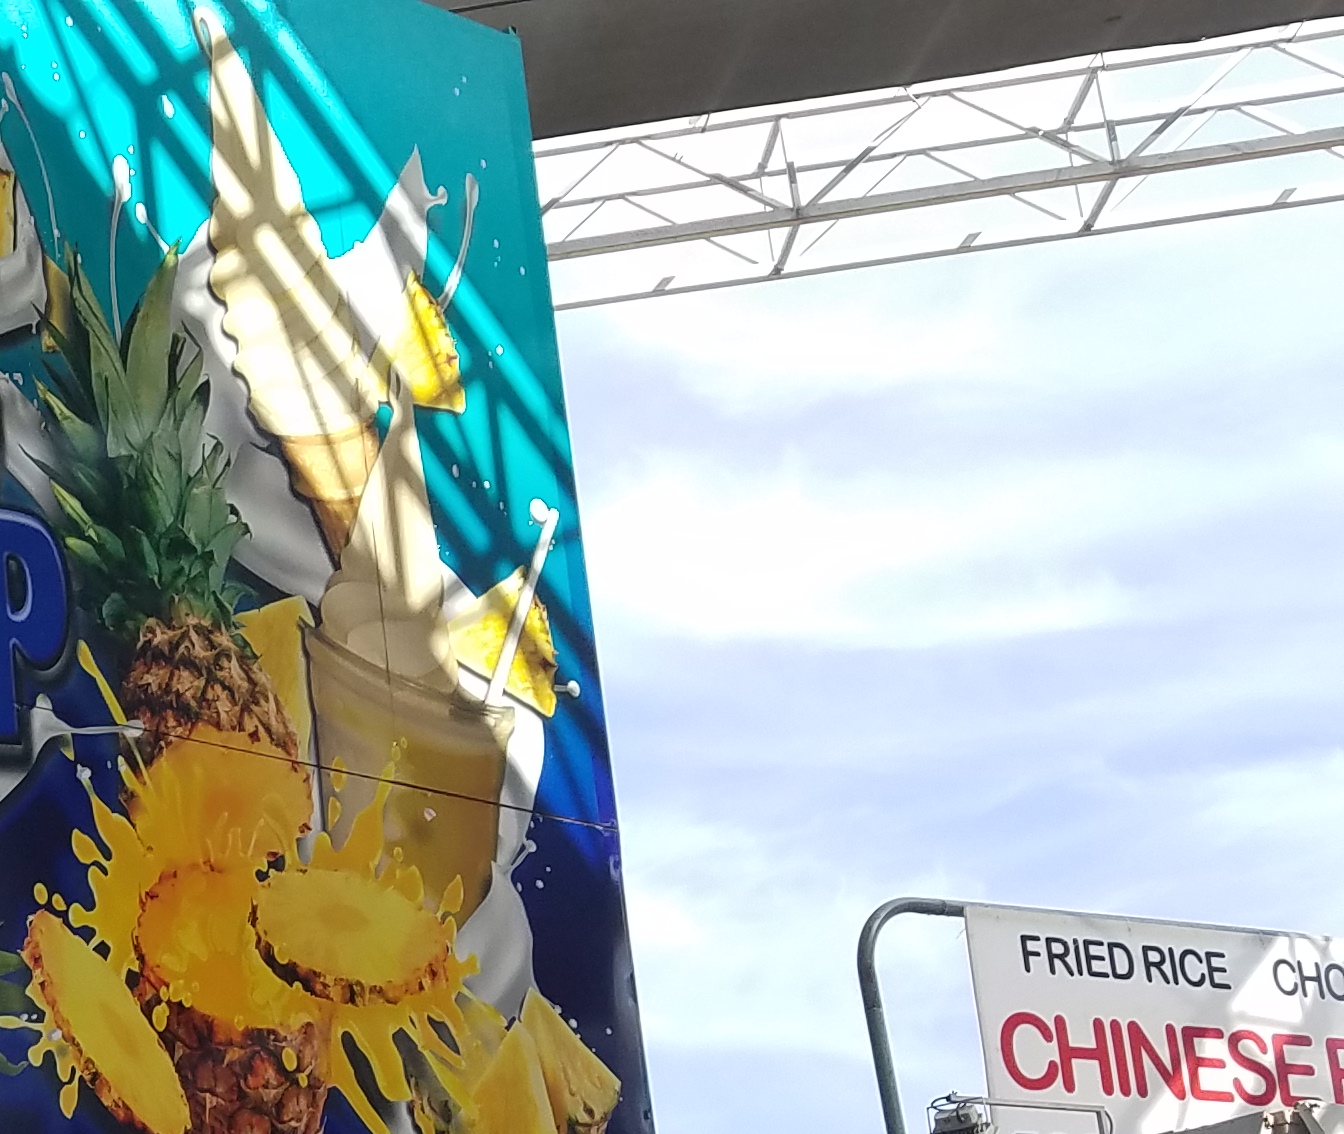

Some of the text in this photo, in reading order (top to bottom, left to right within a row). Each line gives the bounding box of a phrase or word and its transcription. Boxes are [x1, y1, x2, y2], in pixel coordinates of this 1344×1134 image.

[1019, 933, 1135, 980] FRIED
[1141, 943, 1233, 991] RICE
[999, 1011, 1320, 1107] CHINESE
